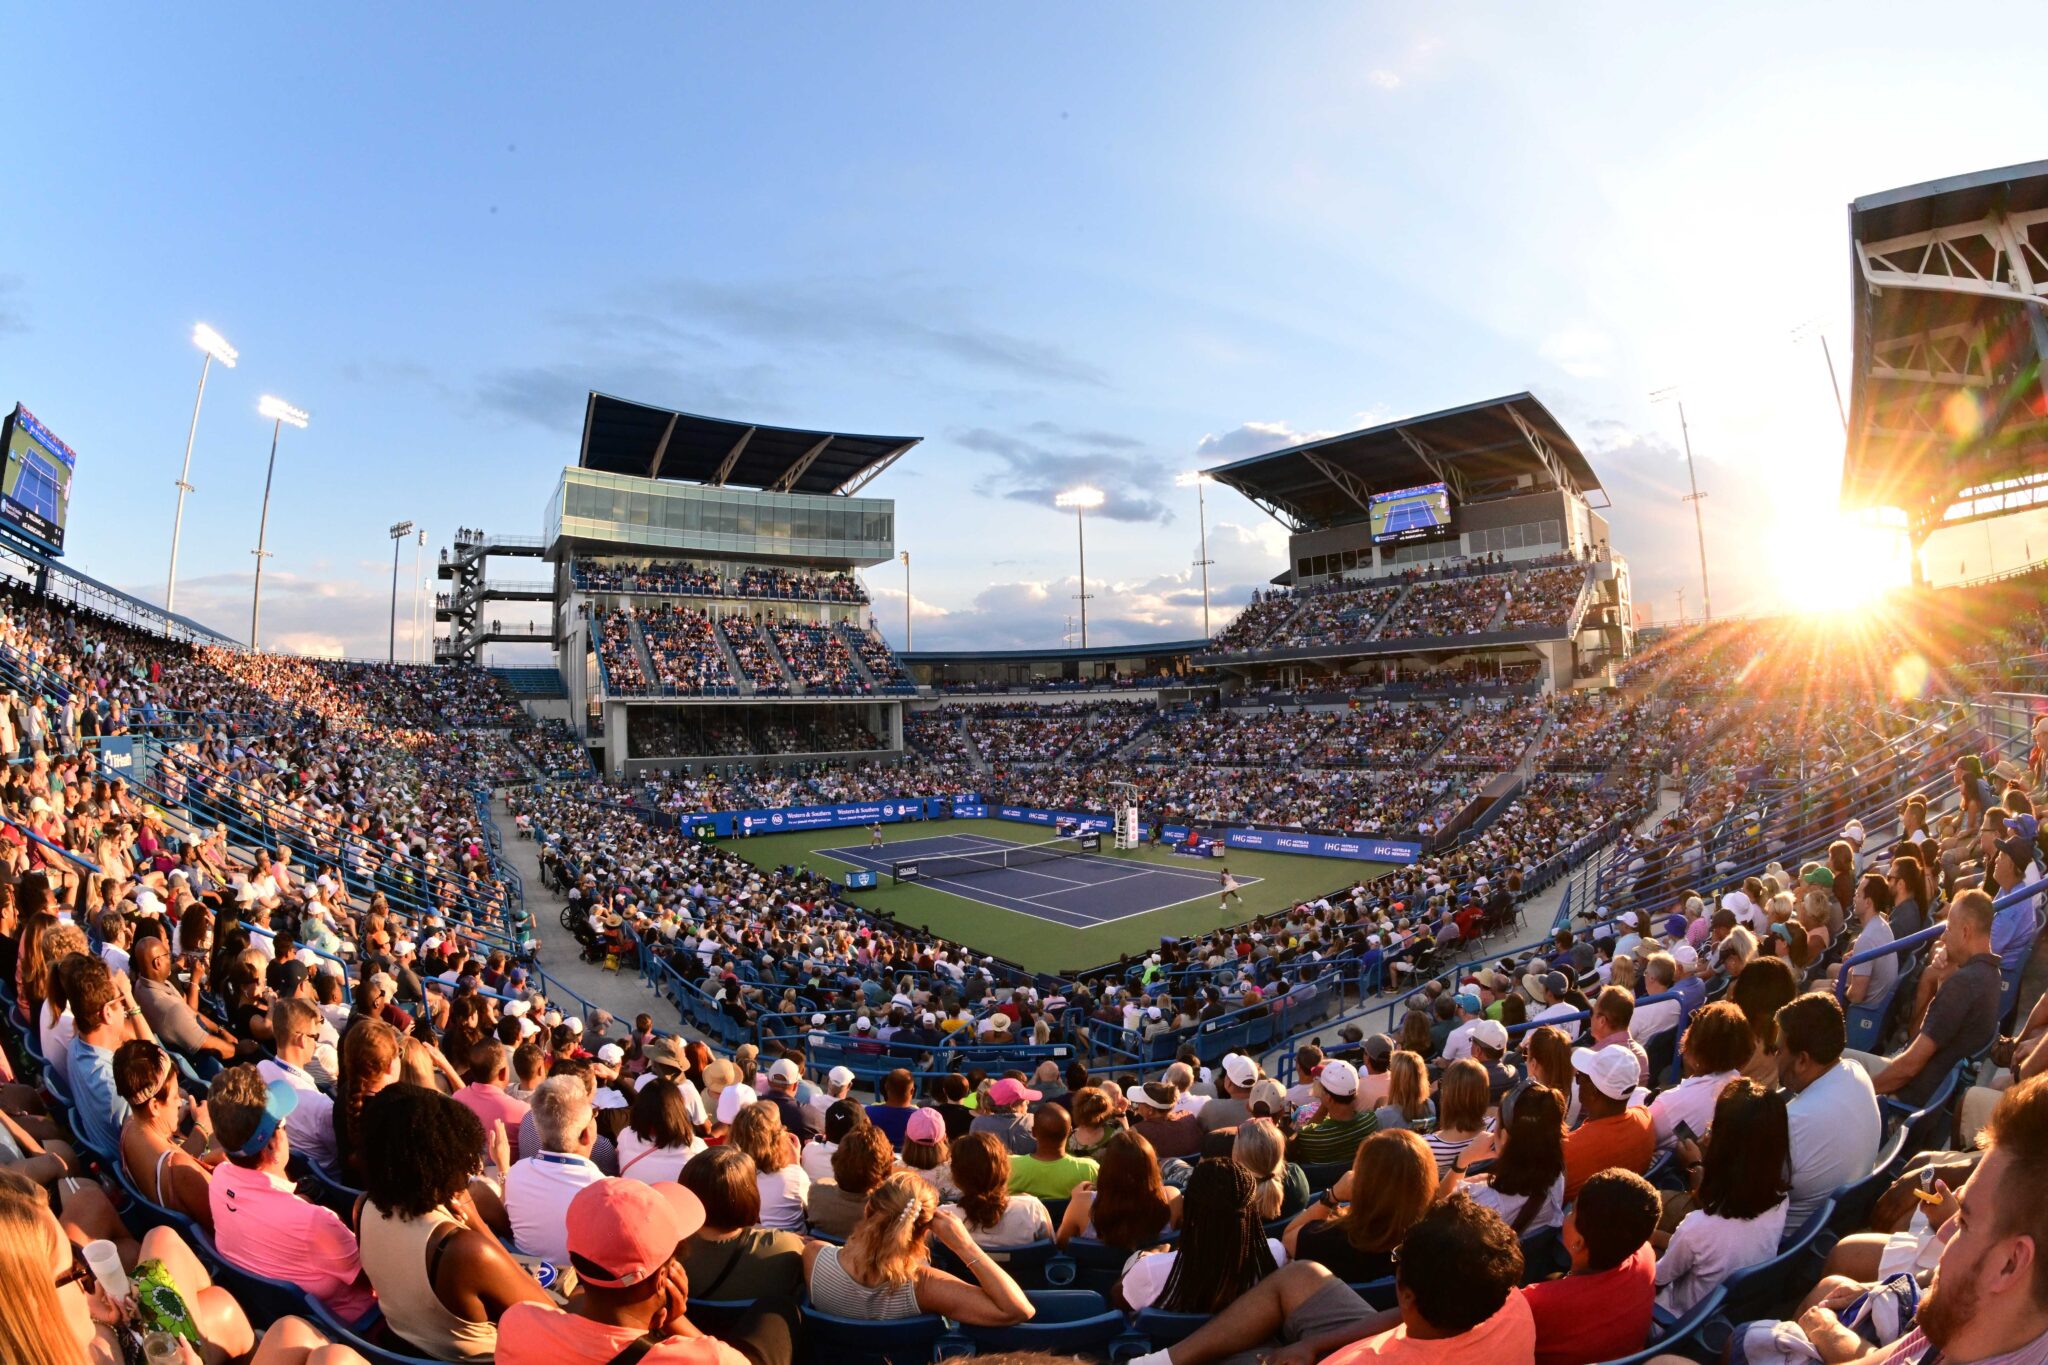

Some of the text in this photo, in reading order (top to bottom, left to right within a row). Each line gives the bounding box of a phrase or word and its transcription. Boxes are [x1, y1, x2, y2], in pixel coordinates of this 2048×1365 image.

[1232, 834, 1247, 843] IHG
[1277, 838, 1292, 847] IHG
[1324, 842, 1340, 851] IHG
[1374, 846, 1391, 856] IHG
